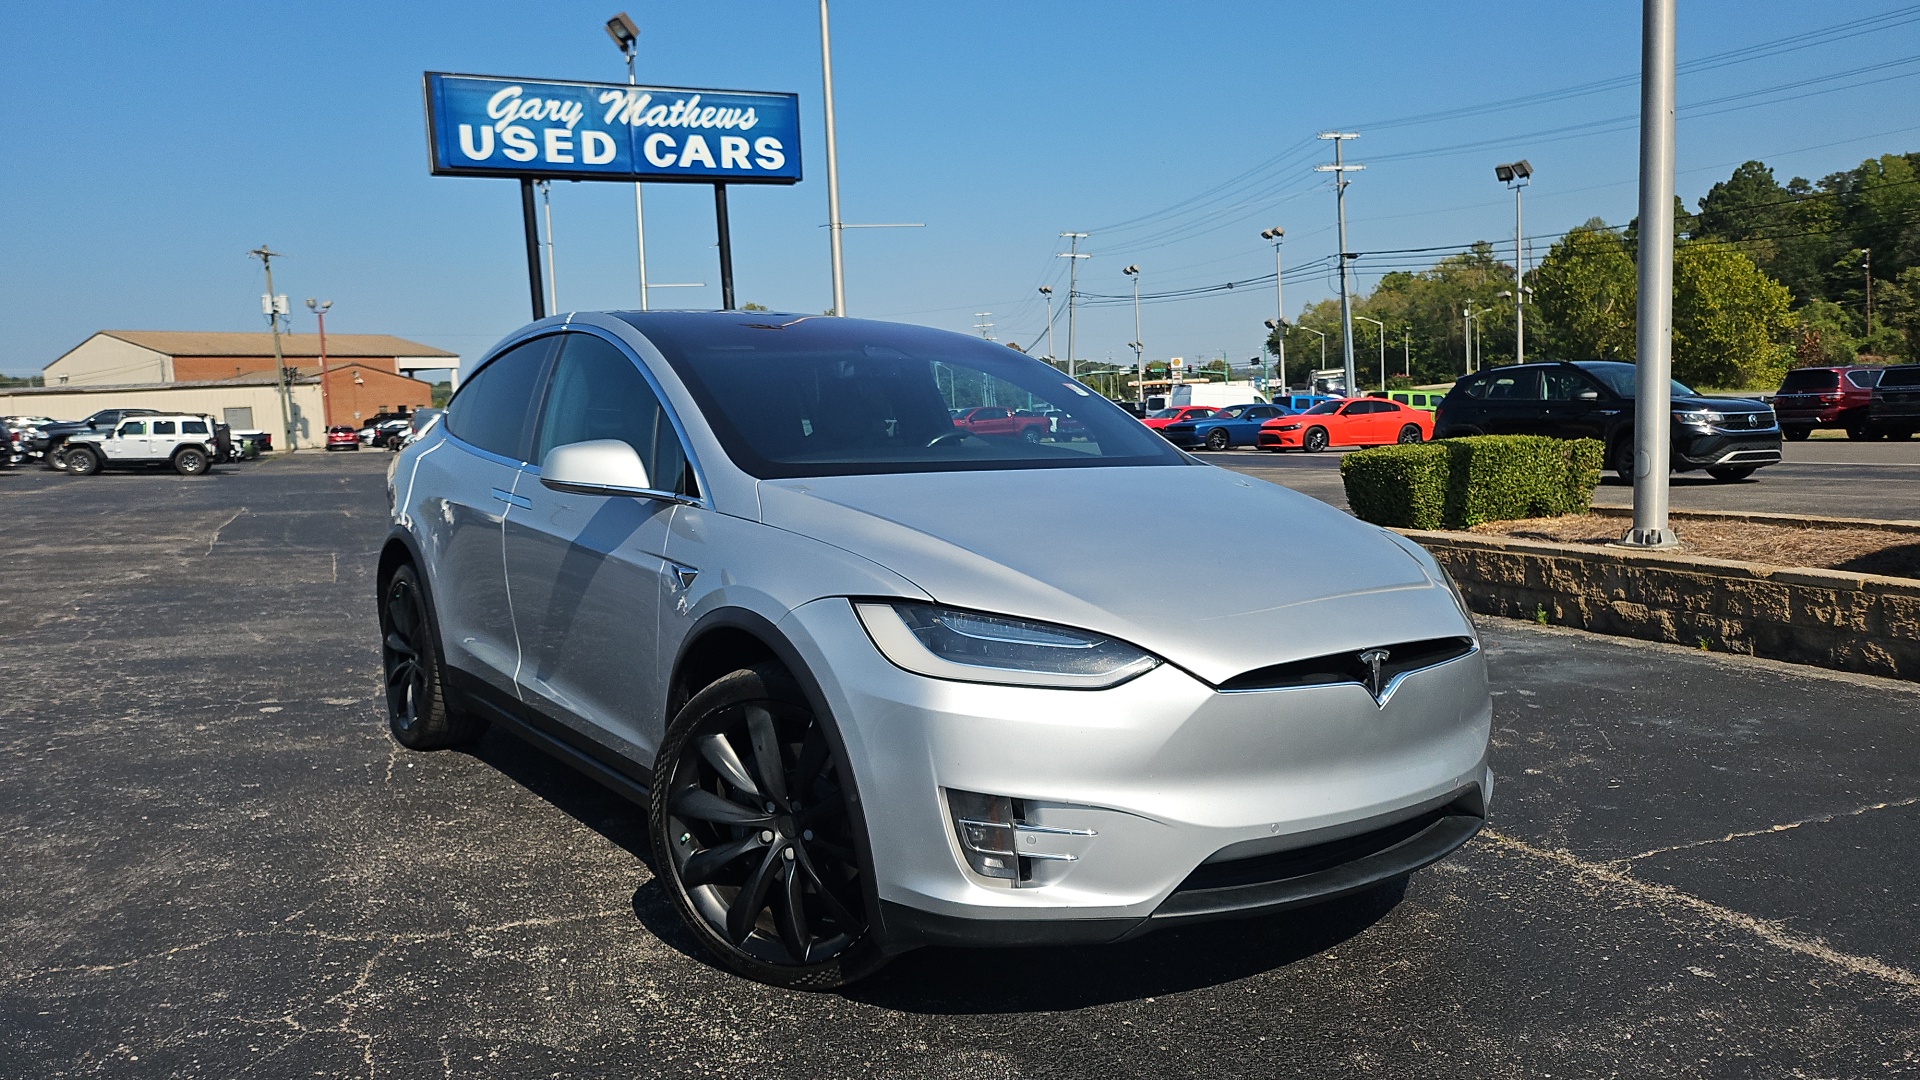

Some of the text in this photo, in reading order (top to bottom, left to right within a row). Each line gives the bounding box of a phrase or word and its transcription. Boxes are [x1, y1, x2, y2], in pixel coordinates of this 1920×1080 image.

[487, 86, 759, 133] Gary Mathews
[459, 124, 785, 170] USED CARS
